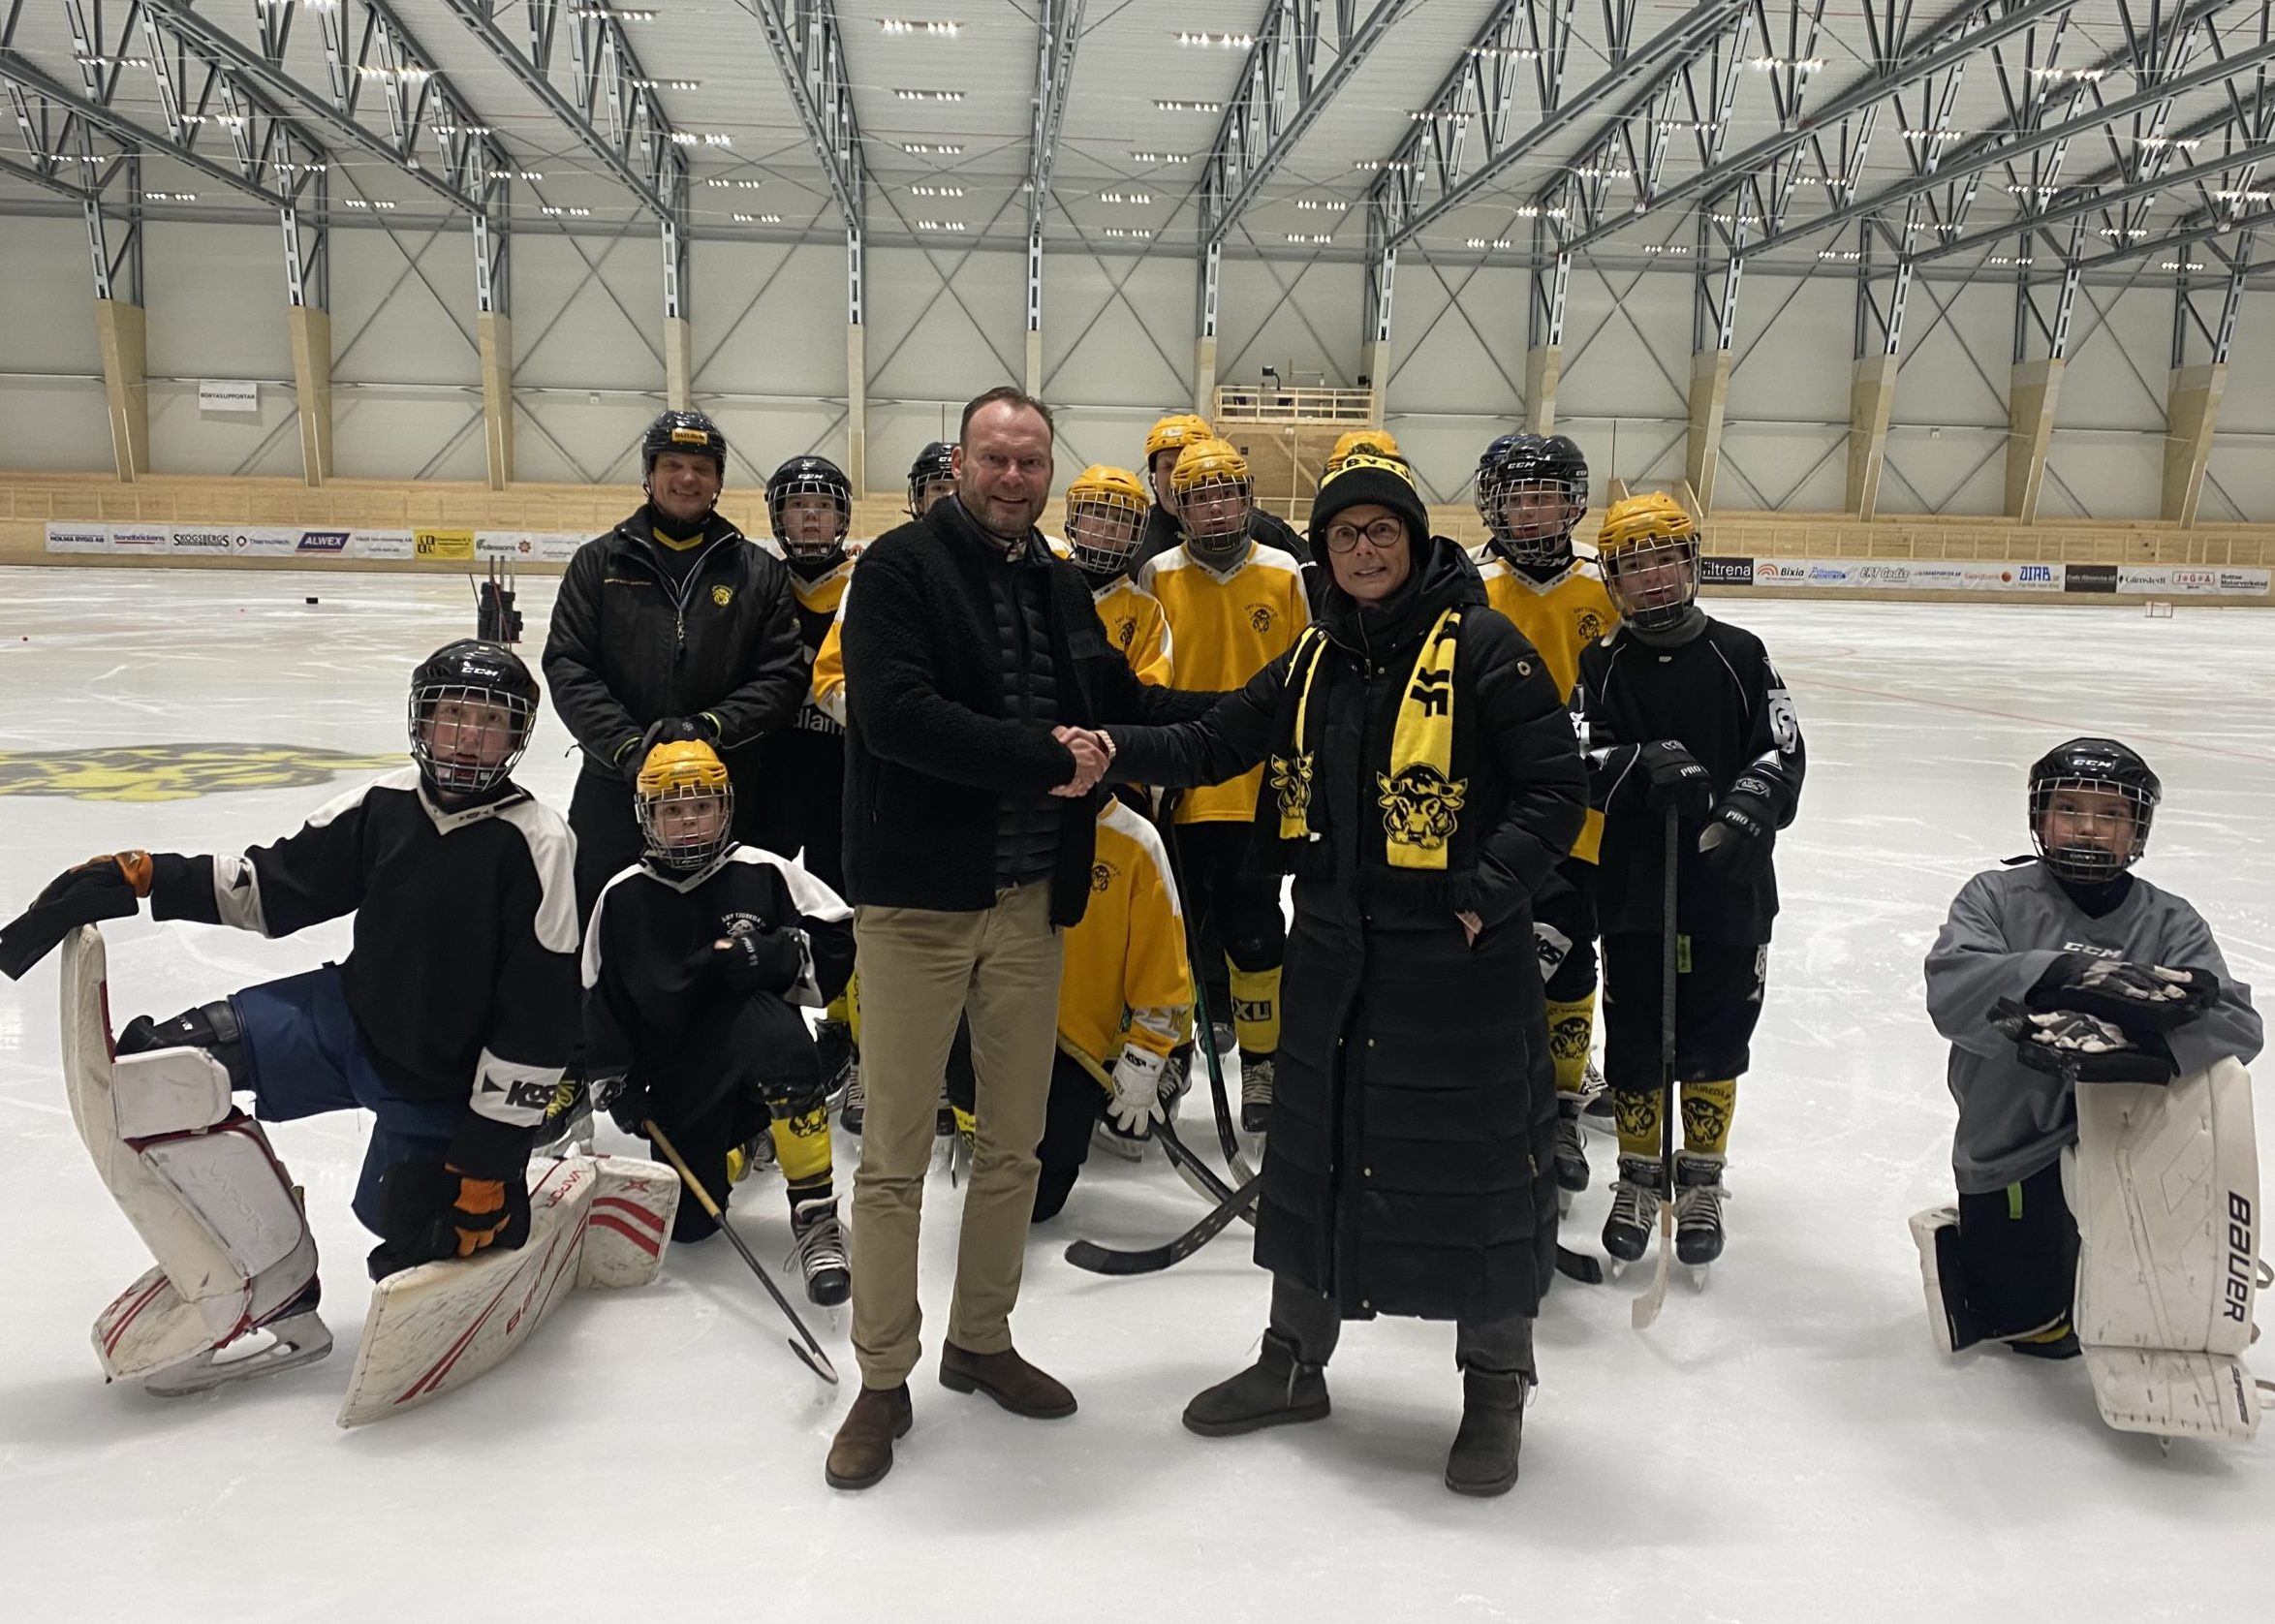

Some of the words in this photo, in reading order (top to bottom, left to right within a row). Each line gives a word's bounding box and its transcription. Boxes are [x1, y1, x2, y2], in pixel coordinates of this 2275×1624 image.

[1507, 460, 1536, 470] CCM
[172, 534, 230, 547] SKOGSBERGS
[304, 536, 343, 546] ALWEX
[1780, 567, 1804, 577] Bixia
[461, 667, 499, 676] CCM
[2072, 759, 2113, 768] CCM
[1680, 765, 1702, 777] PRO
[1726, 810, 1749, 826] PRO
[2063, 941, 2123, 958] CCM
